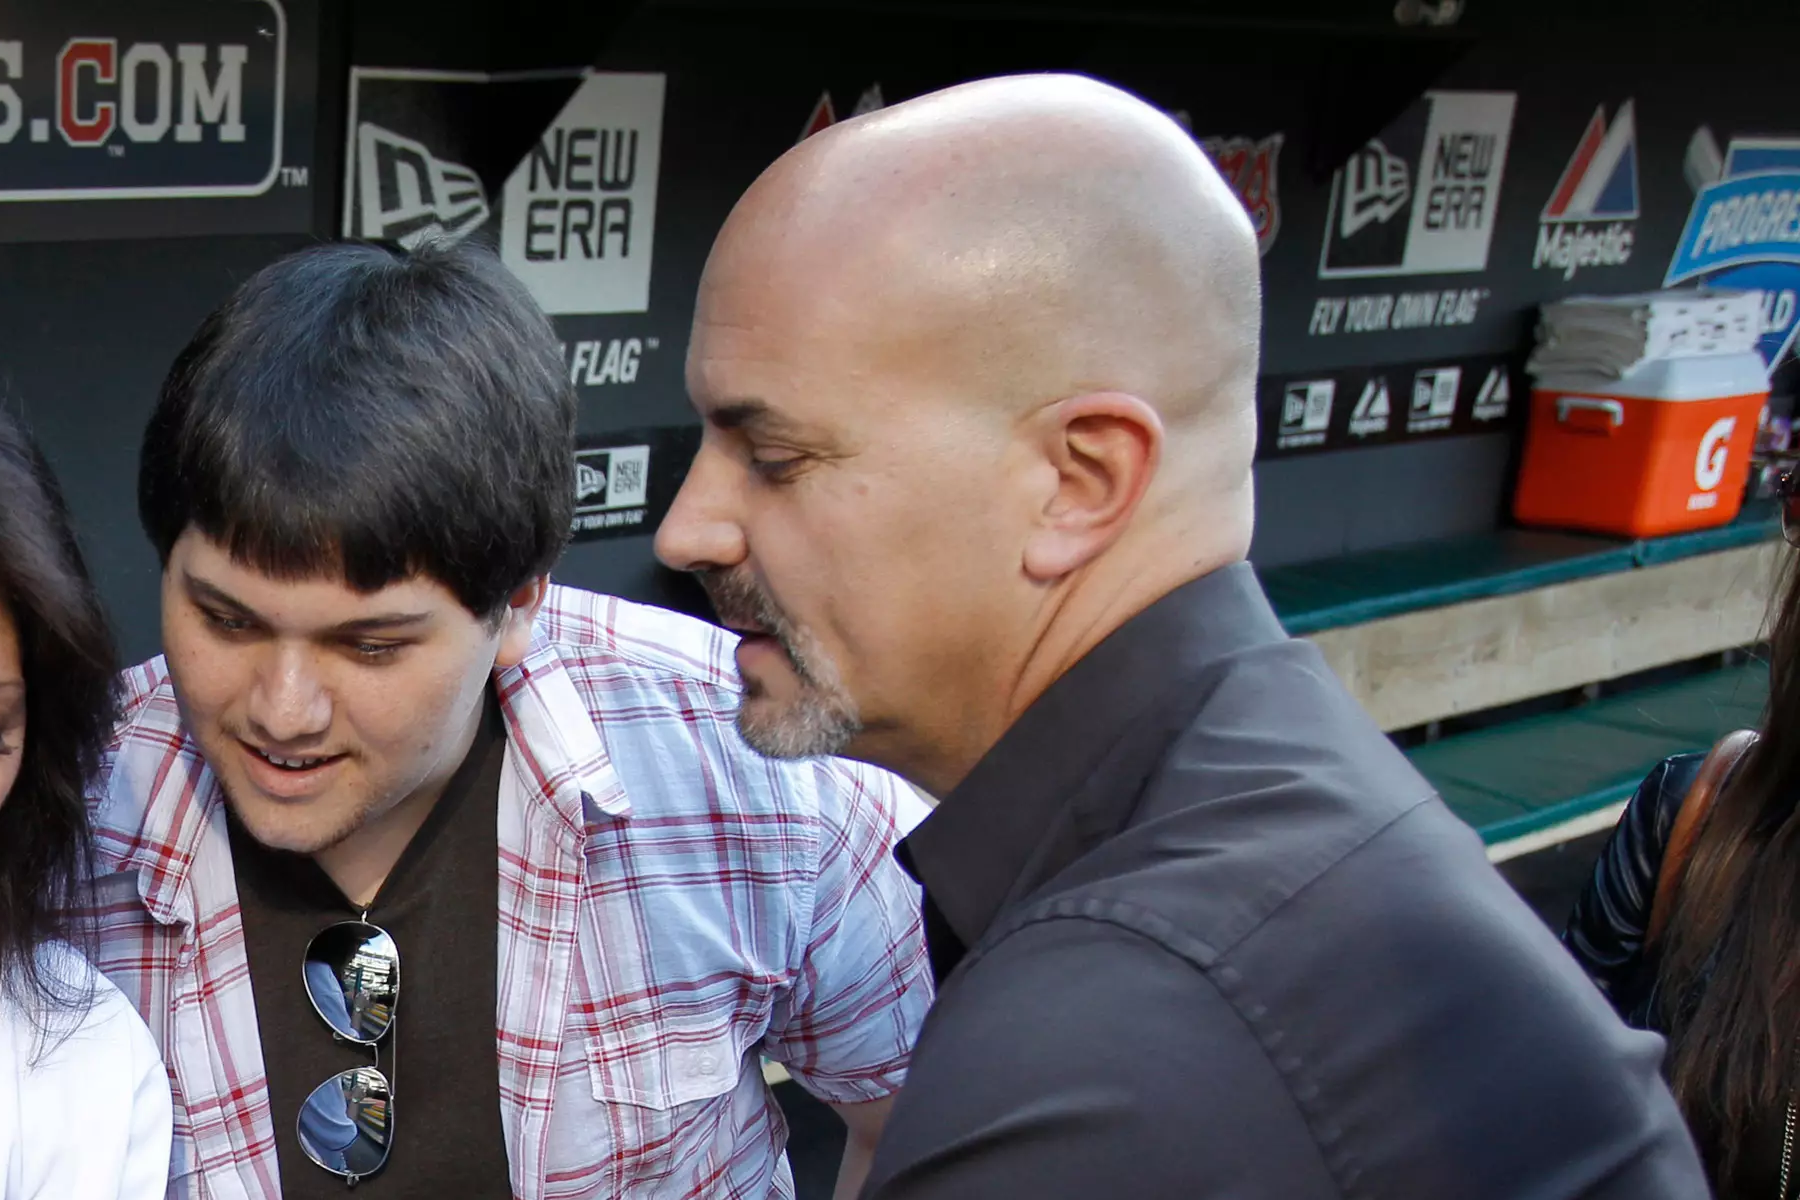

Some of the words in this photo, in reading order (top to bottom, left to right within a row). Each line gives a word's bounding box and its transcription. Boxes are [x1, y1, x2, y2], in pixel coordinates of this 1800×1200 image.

[527, 127, 639, 192] NEW
[1431, 133, 1498, 181] NEW
[525, 197, 632, 262] ERA
[1423, 184, 1485, 232] ERA
[1532, 221, 1635, 282] Majestic
[1309, 297, 1346, 336] FLY
[1344, 294, 1394, 334] YOUR
[1391, 291, 1441, 330] OWN
[1435, 288, 1481, 326] FLAG
[570, 337, 642, 386] FLAG
[616, 460, 640, 476] NEW
[1694, 415, 1738, 491] G
[614, 477, 641, 494] ERA
